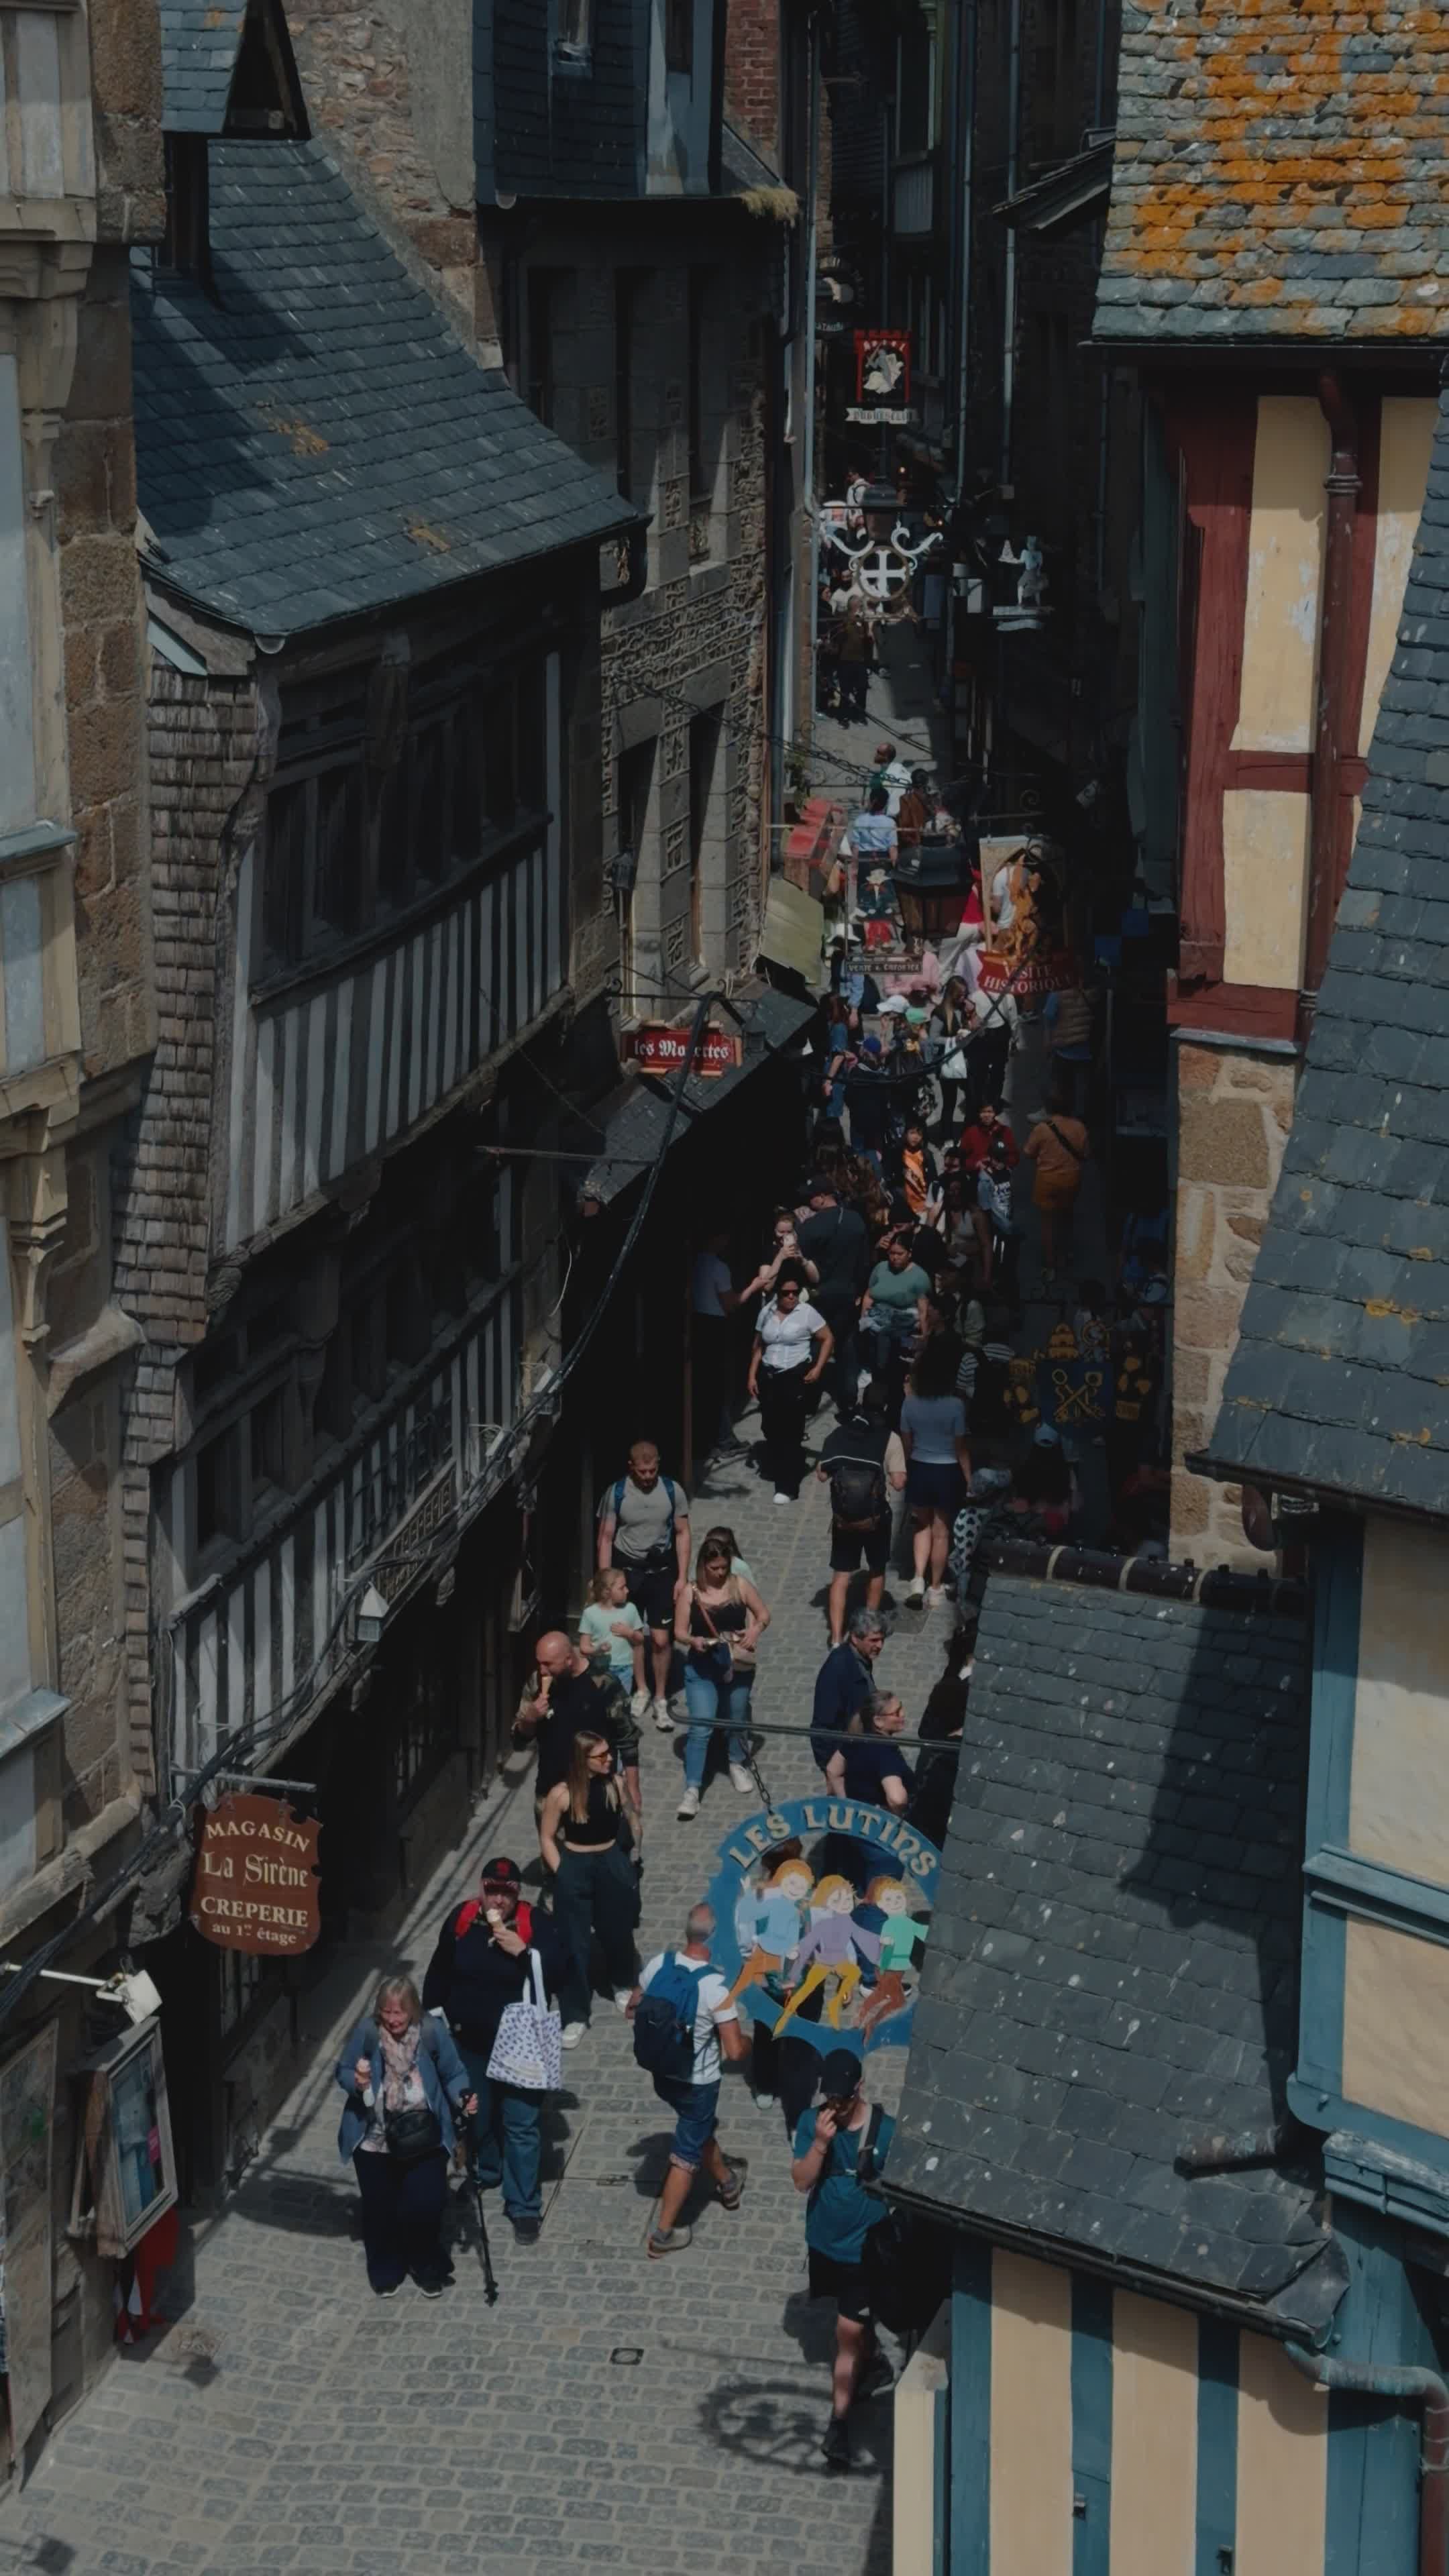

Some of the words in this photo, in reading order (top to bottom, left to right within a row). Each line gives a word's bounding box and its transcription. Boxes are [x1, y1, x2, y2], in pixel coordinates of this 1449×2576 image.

[205, 1821, 309, 1852] MAGASIN
[729, 1815, 791, 1870] LES
[203, 1852, 233, 1878] La
[244, 1854, 309, 1888] Sirène
[200, 1896, 309, 1927] CREPERIE
[212, 1923, 231, 1935] au
[256, 1927, 297, 1946] étage
